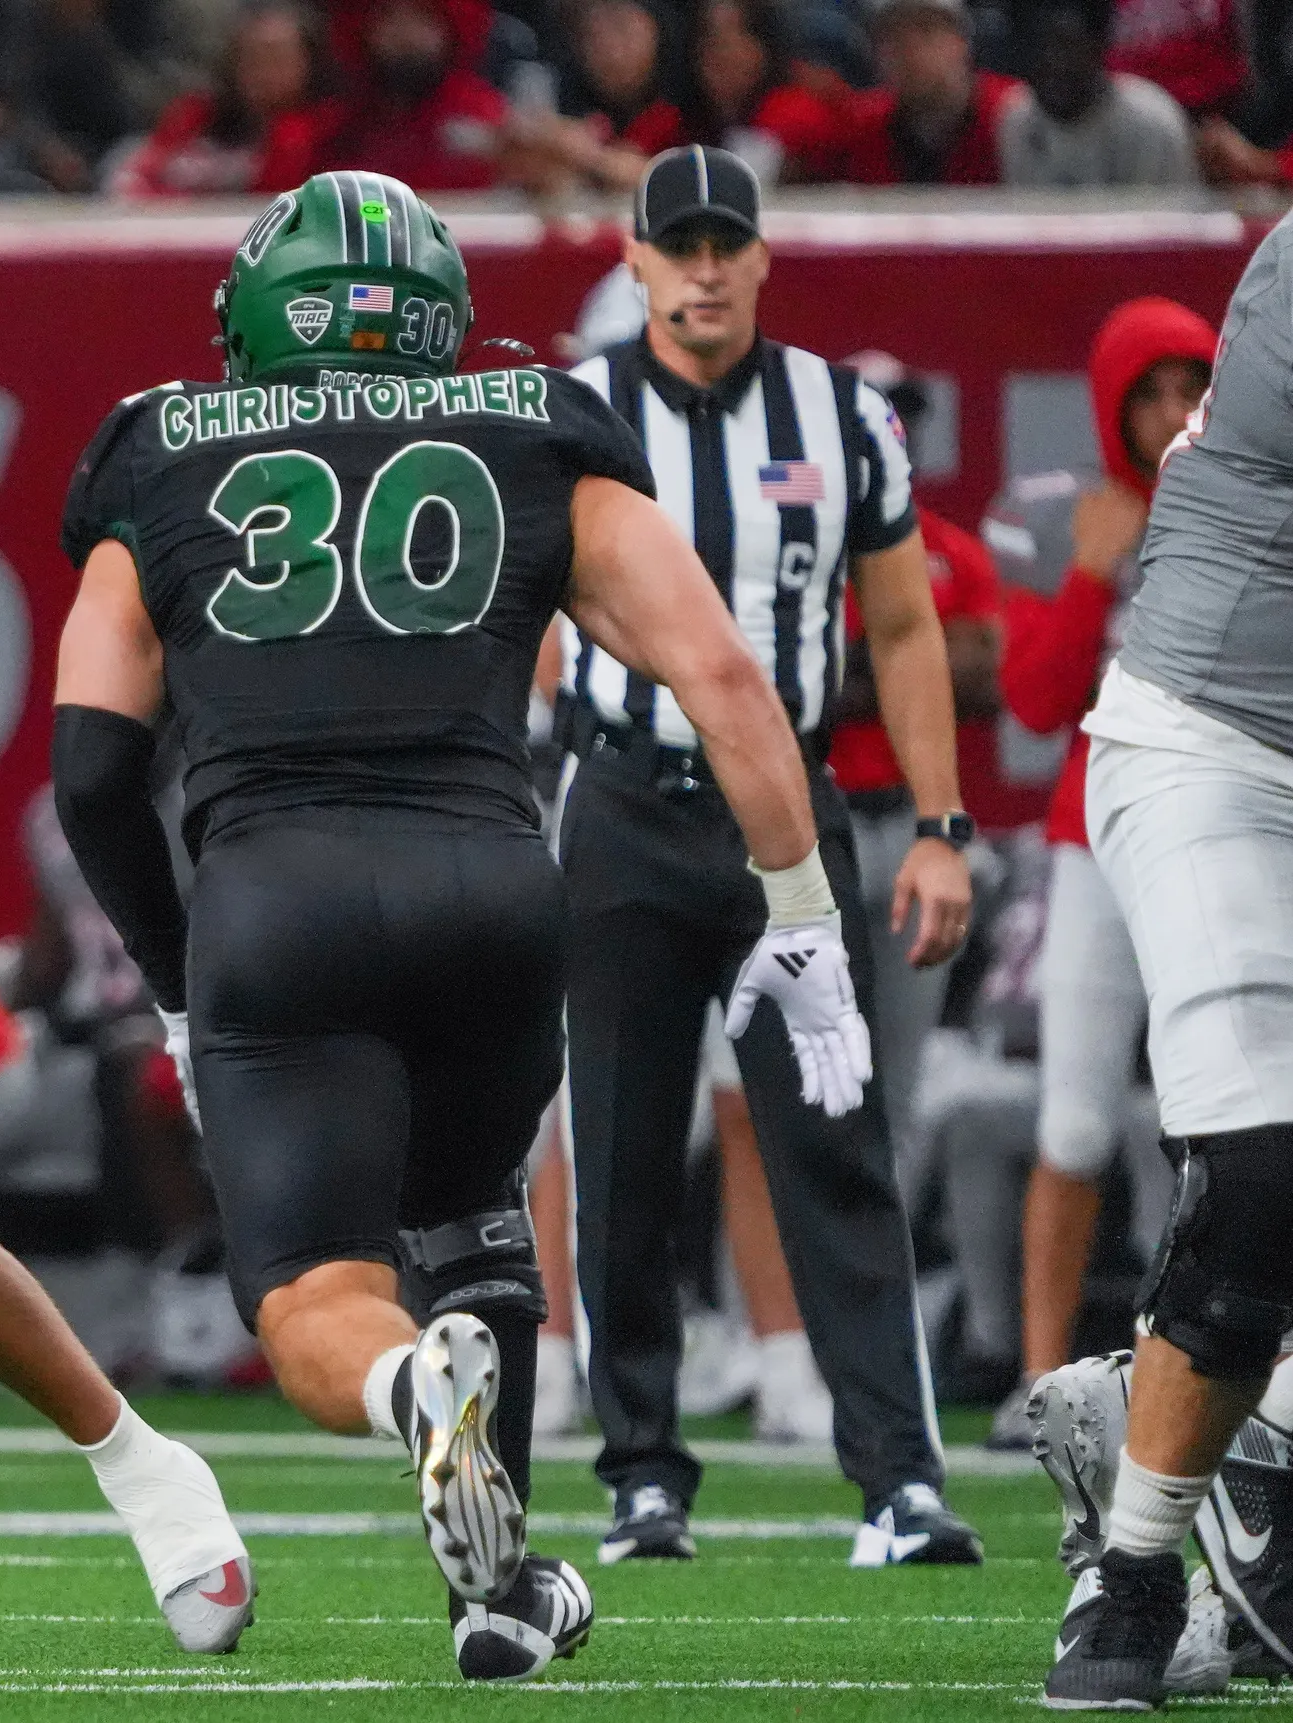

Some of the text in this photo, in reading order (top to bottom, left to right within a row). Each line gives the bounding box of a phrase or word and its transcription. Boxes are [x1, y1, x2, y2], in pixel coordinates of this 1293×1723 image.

[290, 312, 331, 324] MAC
[398, 298, 454, 359] 30
[161, 369, 550, 452] CHRISTOPHER
[207, 440, 505, 641] 30
[779, 540, 815, 589] C
